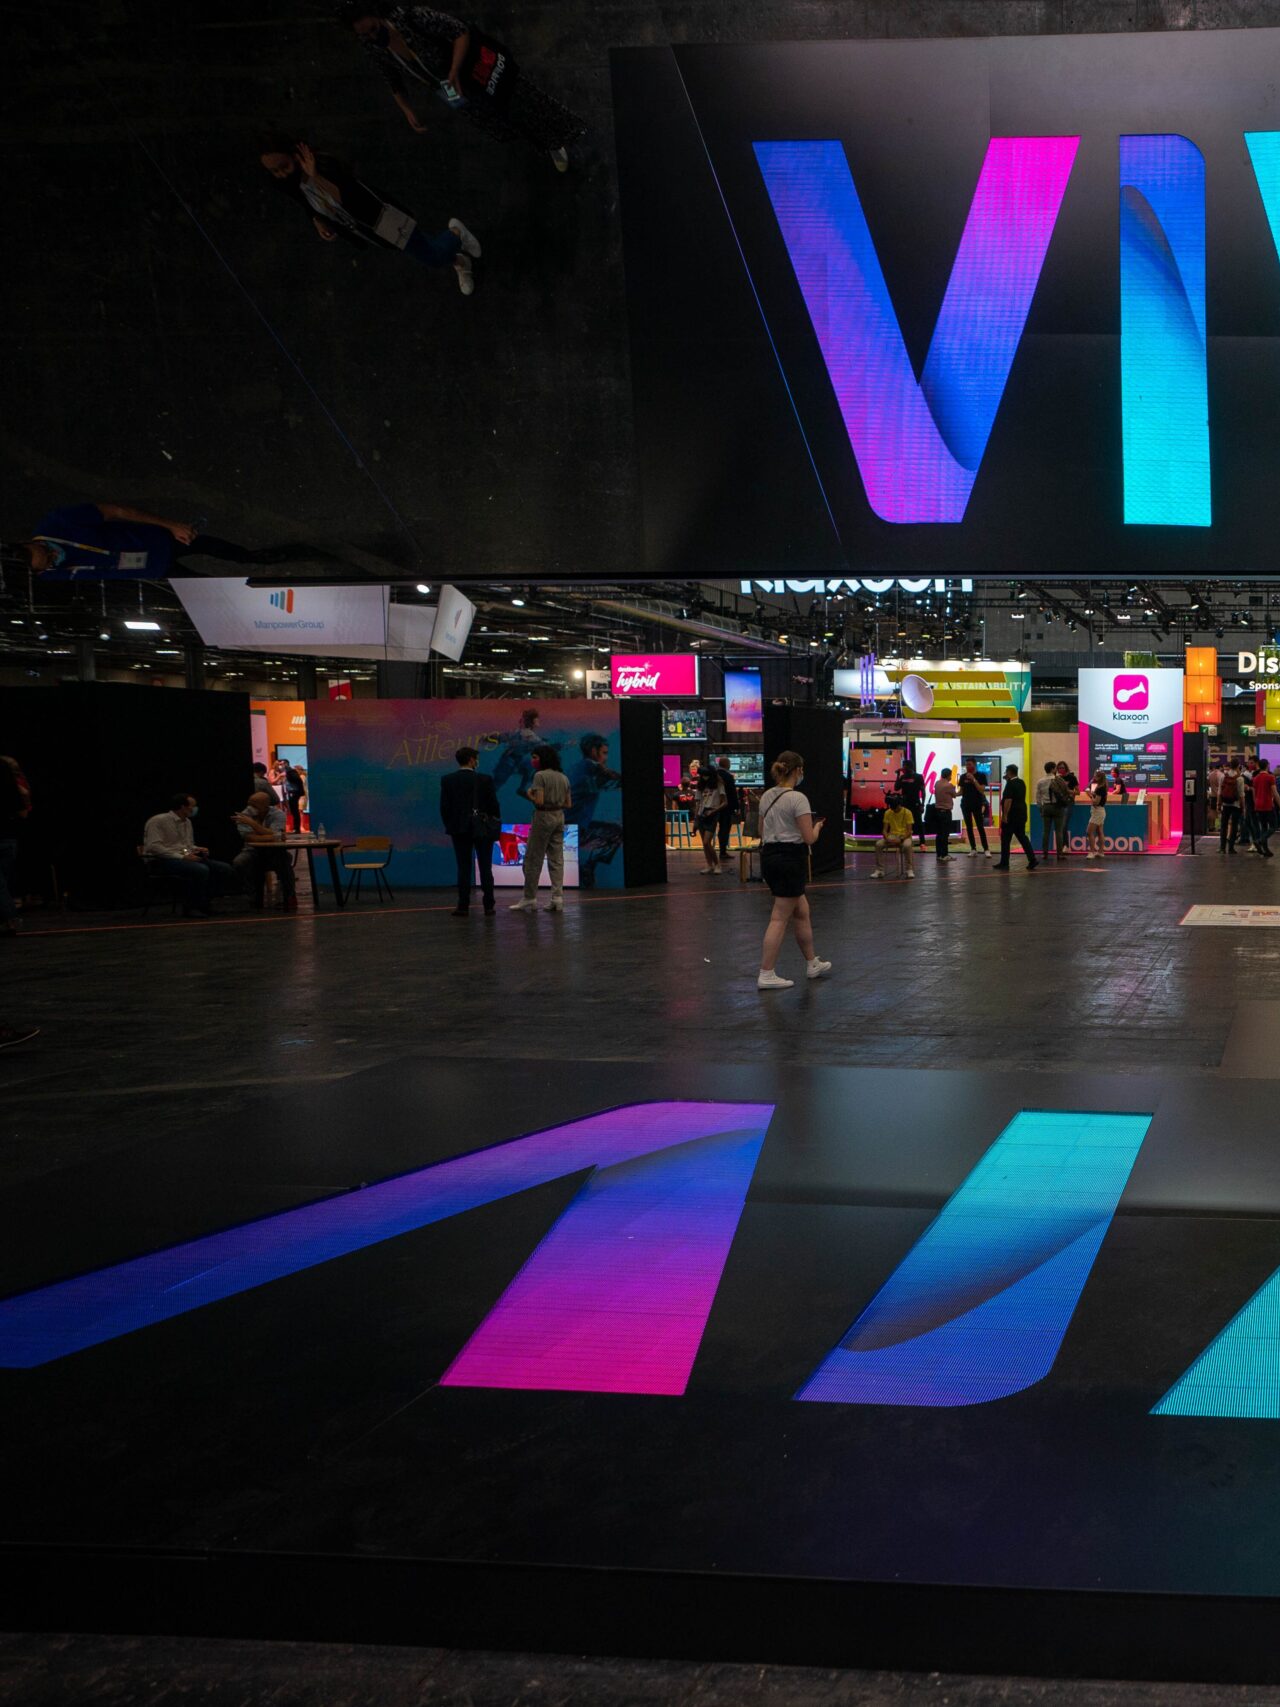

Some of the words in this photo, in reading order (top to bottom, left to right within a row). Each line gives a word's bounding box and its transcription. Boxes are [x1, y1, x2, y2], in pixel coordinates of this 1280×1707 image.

[254, 619, 325, 631] ManpowerGroup
[616, 672, 661, 692] hybrid
[1112, 712, 1150, 721] klaxoon
